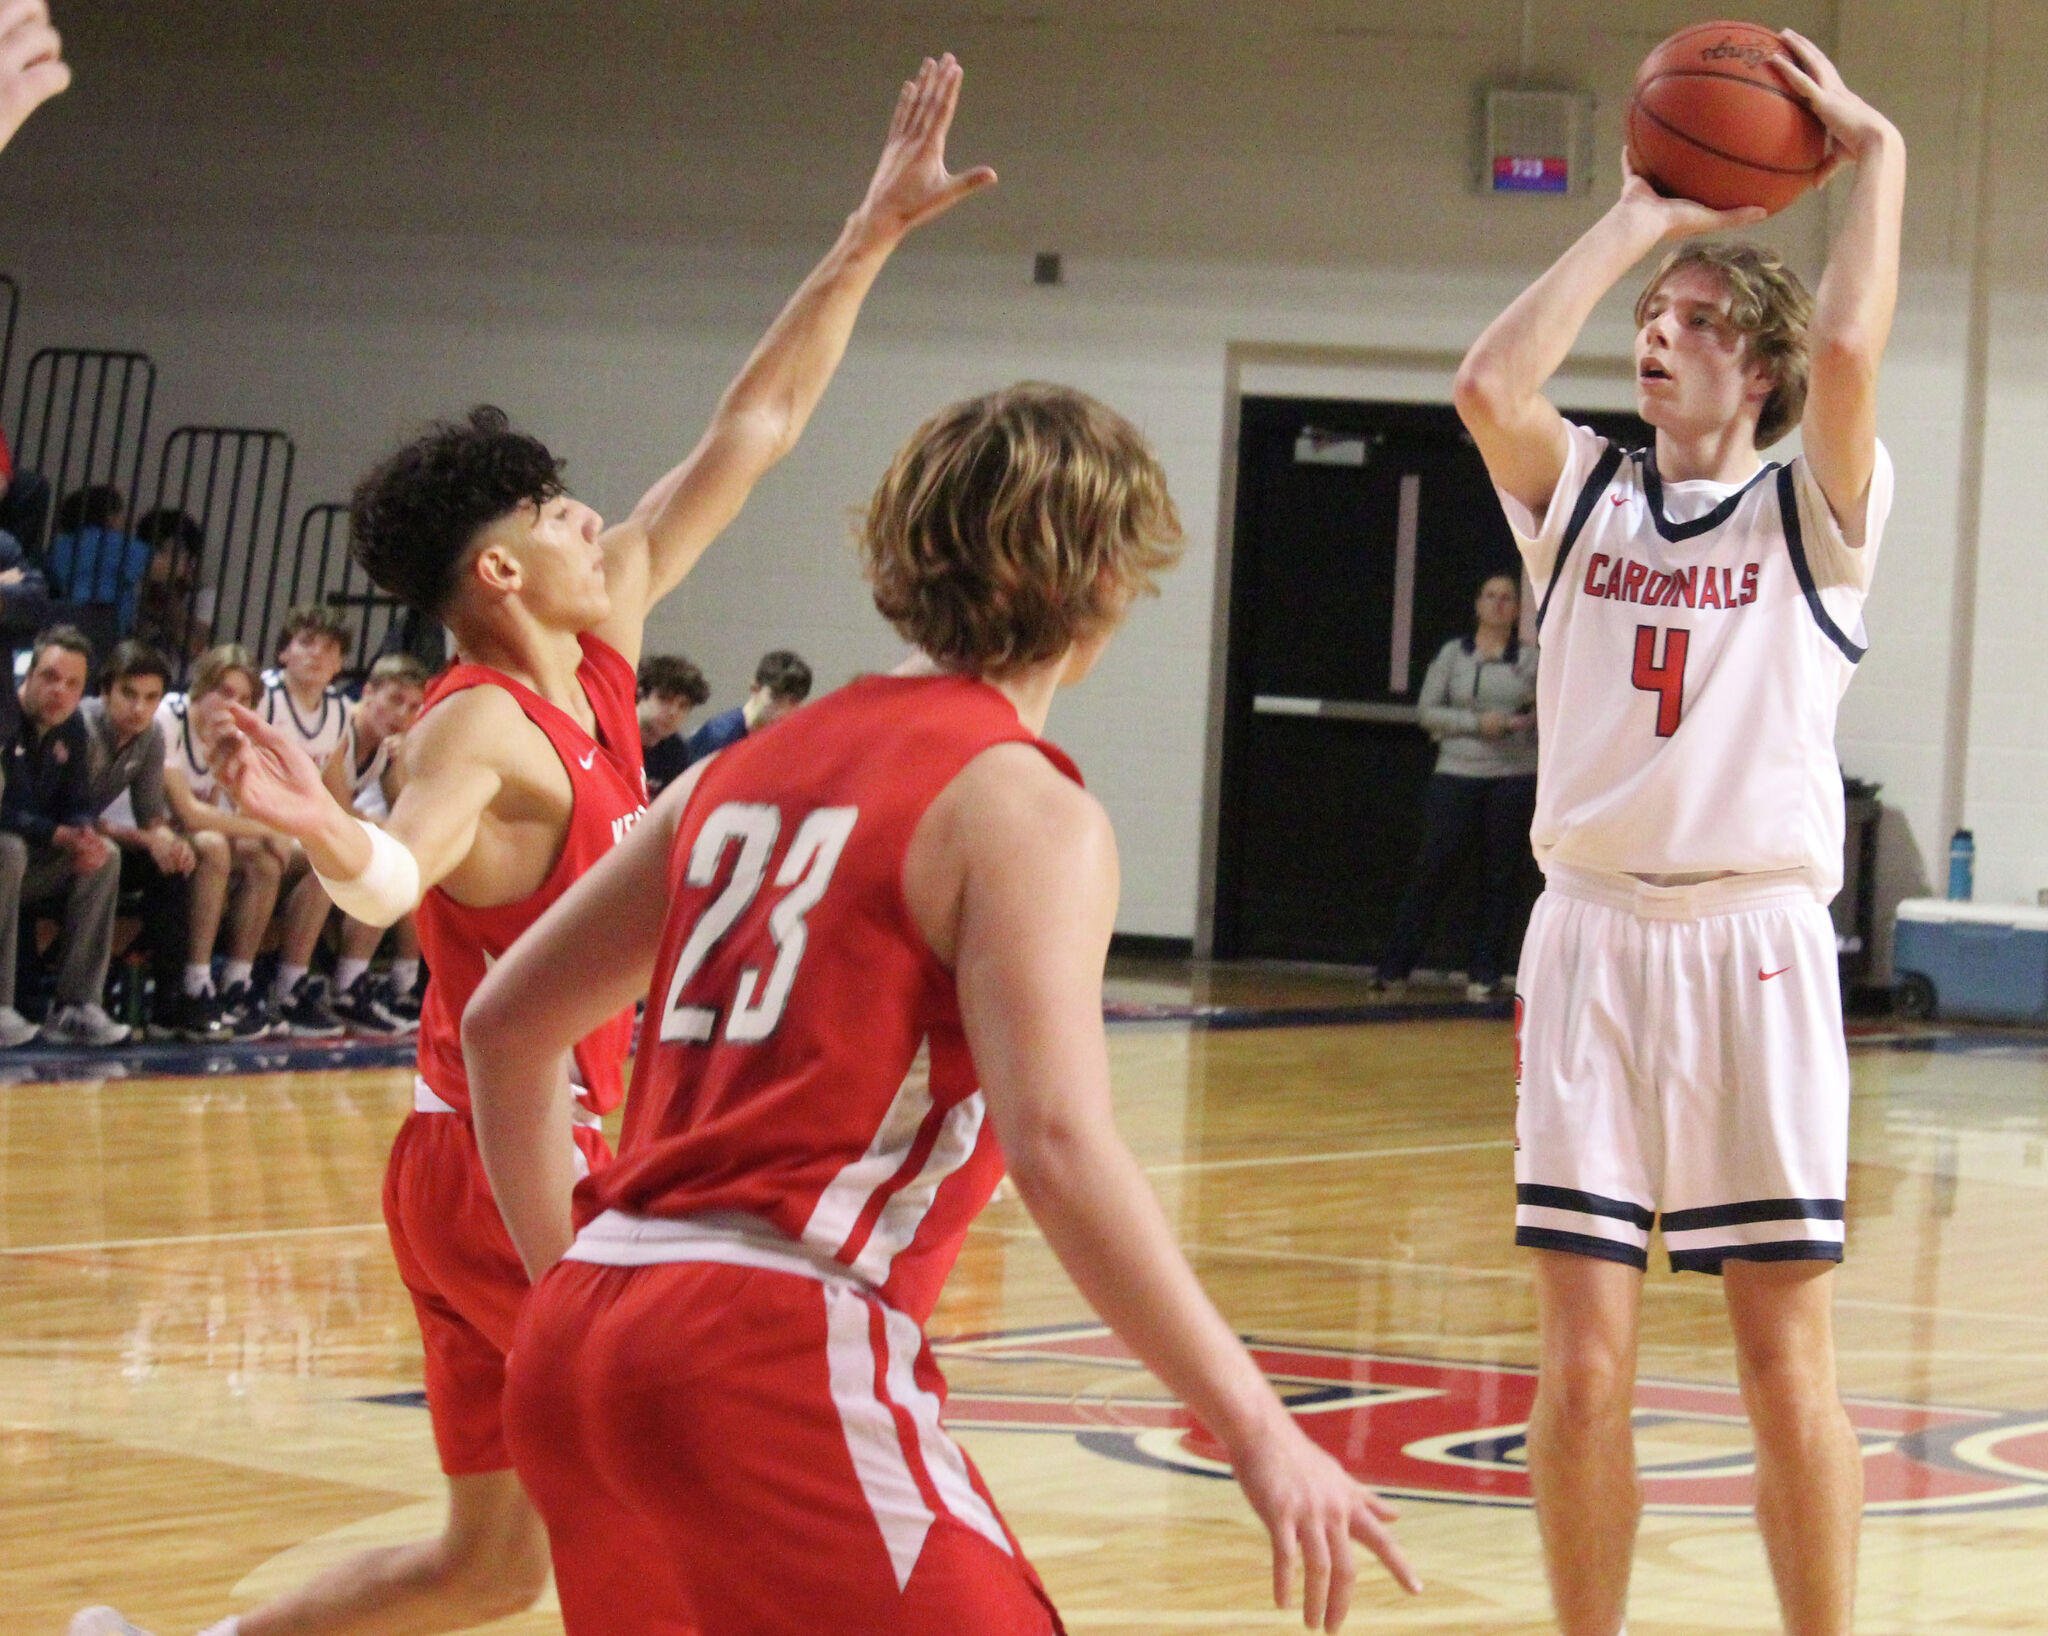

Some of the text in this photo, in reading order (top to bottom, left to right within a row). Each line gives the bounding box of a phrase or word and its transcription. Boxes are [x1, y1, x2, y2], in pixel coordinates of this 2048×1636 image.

[1584, 553, 1759, 609] CARDINALS
[1631, 625, 1690, 737] 4
[659, 802, 859, 1042] 23
